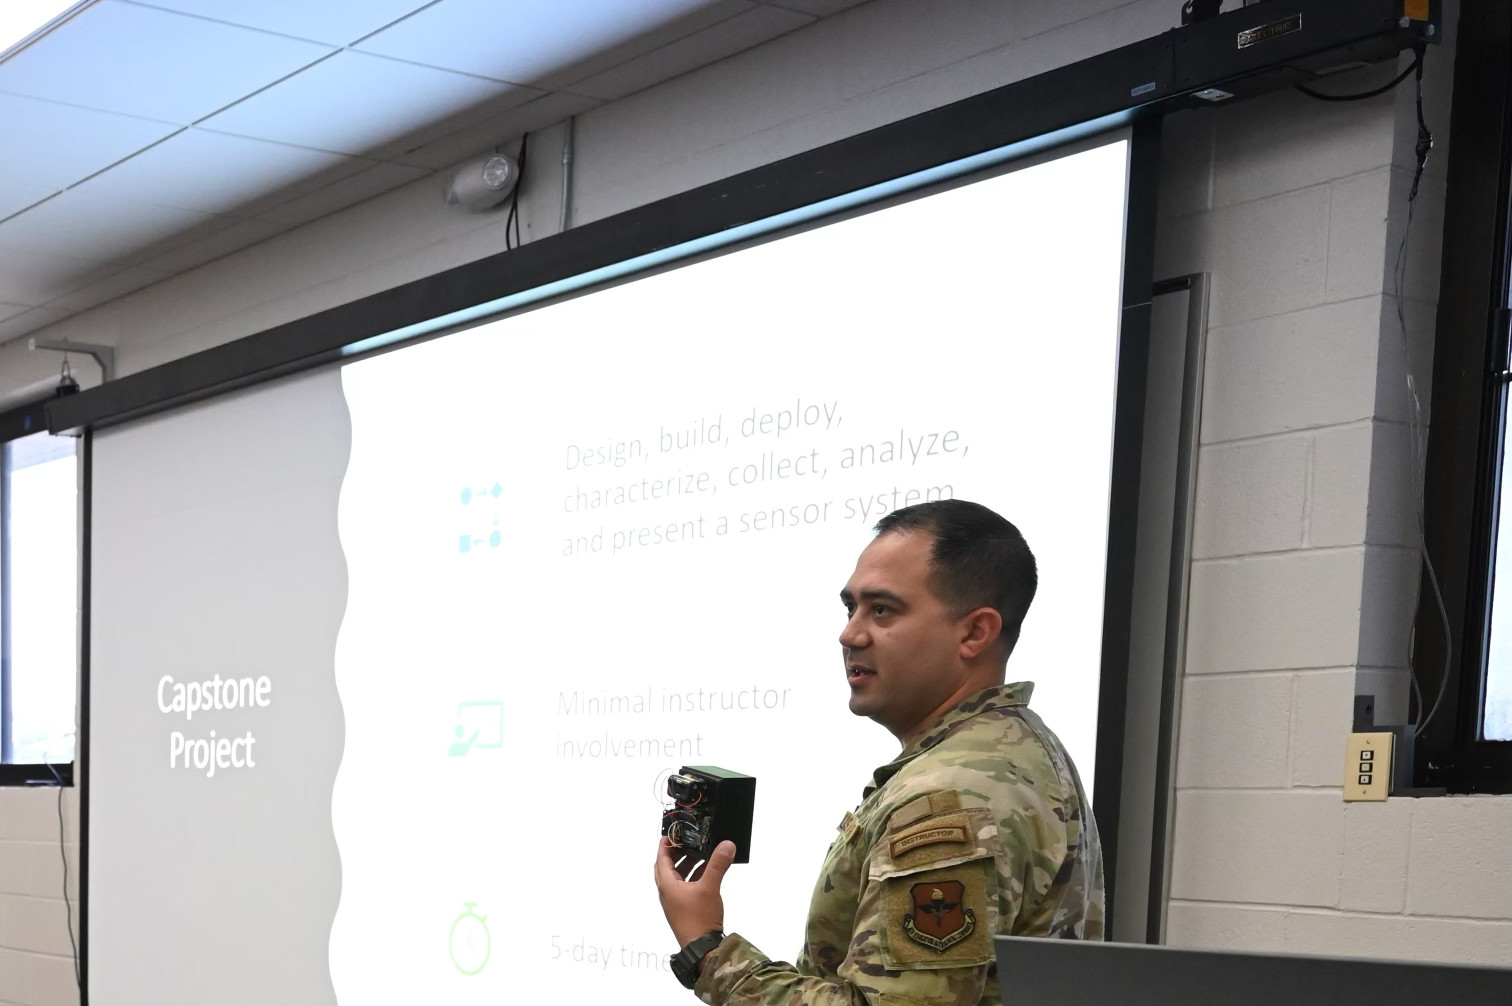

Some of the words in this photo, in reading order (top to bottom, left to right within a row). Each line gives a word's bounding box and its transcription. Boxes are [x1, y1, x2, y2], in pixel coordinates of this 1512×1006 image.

[566, 438, 649, 471] Design,
[659, 413, 729, 453] build,
[741, 397, 843, 438] deploy,
[564, 469, 717, 513] characterize,
[728, 447, 828, 487] collect,
[840, 429, 970, 470] analyze,
[562, 525, 603, 557] and
[612, 514, 706, 556] present
[716, 517, 728, 536] a
[740, 500, 833, 534] sensor
[157, 673, 271, 721] Capstone
[558, 686, 652, 716] Minimal
[662, 685, 792, 713] instructor
[170, 730, 256, 777] Project
[557, 732, 704, 759] involvement
[901, 830, 954, 847] INSTRUCTOR
[551, 935, 612, 971] 5-day
